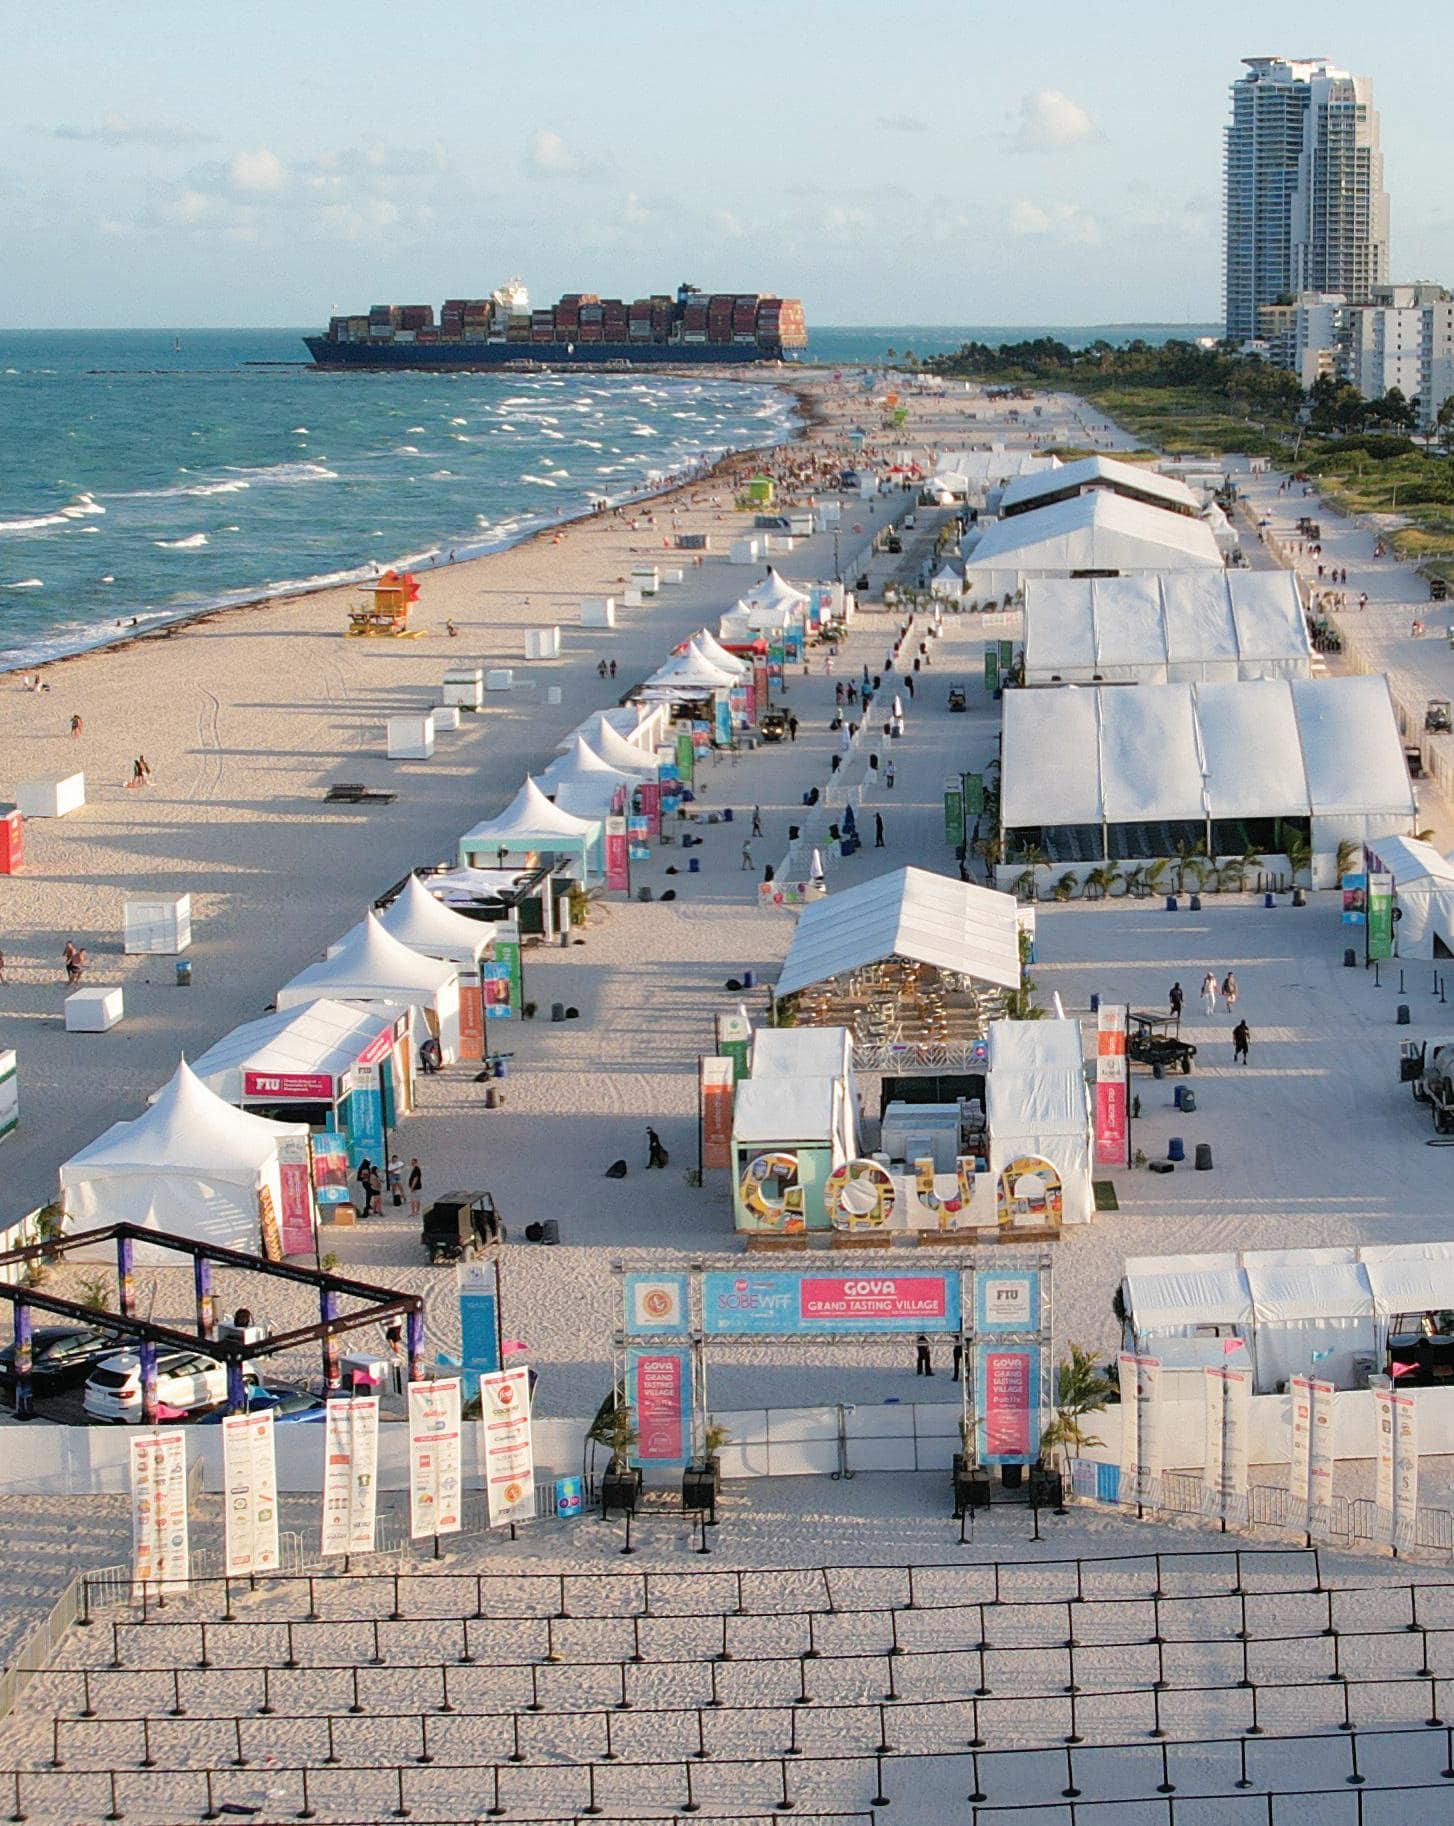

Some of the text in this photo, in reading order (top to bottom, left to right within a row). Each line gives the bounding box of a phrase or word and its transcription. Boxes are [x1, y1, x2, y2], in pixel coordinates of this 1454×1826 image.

[255, 1078, 280, 1091] FIU
[738, 1152, 1064, 1232] GOYA
[844, 1281, 896, 1296] GOYA
[996, 1289, 1019, 1300] FIU
[808, 1299, 939, 1311] GRAND TASTING VILLAGE
[643, 1362, 674, 1370] GOYA
[993, 1359, 1022, 1367] GOYA
[994, 1370, 1022, 1378] GRAND
[643, 1381, 674, 1389] TASTING
[992, 1385, 1023, 1393] VILLAGE
[643, 1389, 674, 1397] VILLAGE
